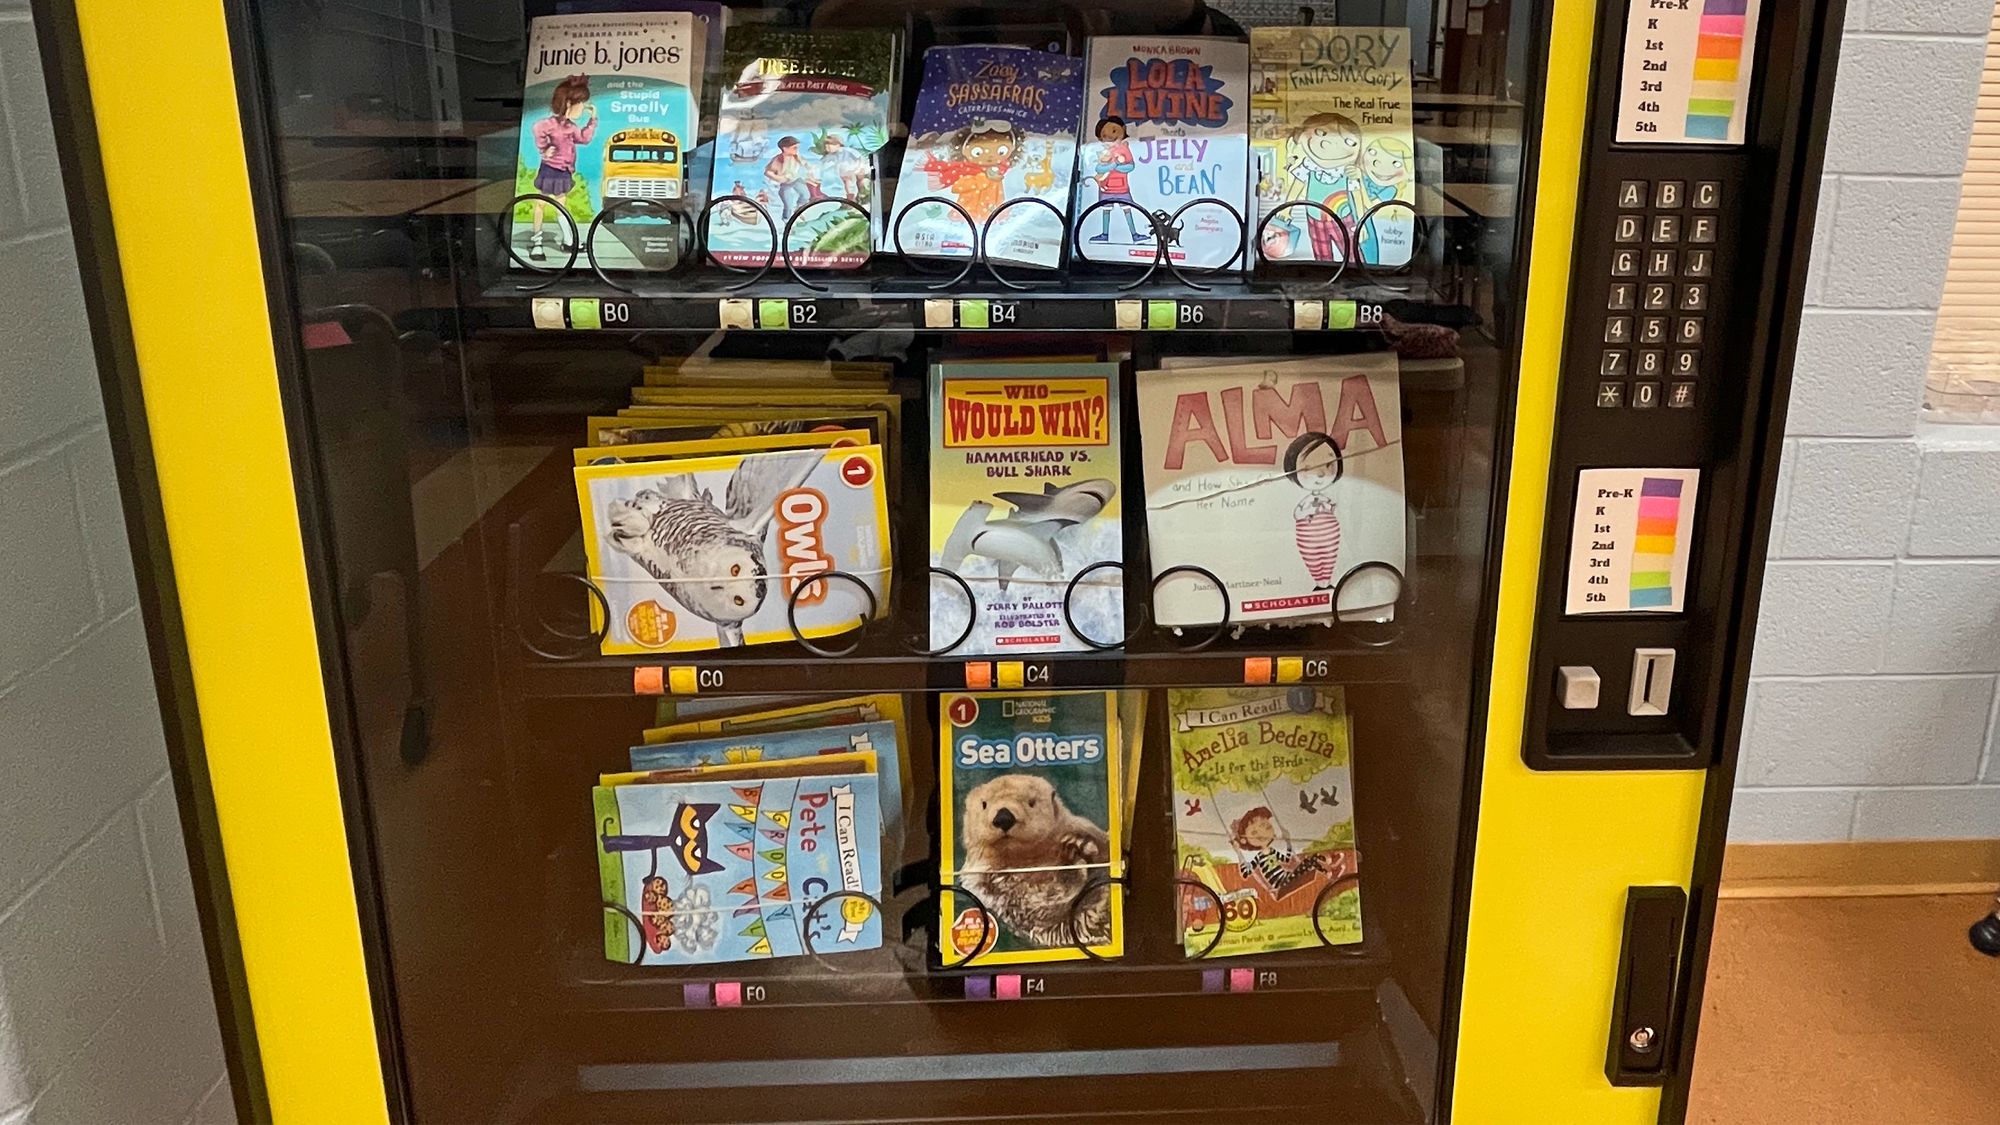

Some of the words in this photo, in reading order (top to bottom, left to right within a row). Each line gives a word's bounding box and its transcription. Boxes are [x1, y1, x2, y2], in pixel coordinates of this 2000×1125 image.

[1648, 19, 1658, 29] K
[1133, 45, 1166, 54] MONICA
[1168, 46, 1201, 55] BROWN
[1300, 34, 1401, 67] DORY
[1645, 39, 1664, 51] 1st
[533, 44, 586, 75] junie
[594, 41, 611, 64] b.
[613, 41, 681, 71] jones
[1643, 60, 1667, 71] 2nd
[974, 59, 1020, 83] Zoey
[1128, 60, 1206, 89] LOLA
[607, 81, 625, 89] and
[1640, 81, 1663, 92] 3rd
[620, 90, 660, 100] Stupid
[946, 84, 1046, 115] SASSAFRAS
[1333, 97, 1351, 109] The
[1354, 97, 1375, 109] Real
[1378, 97, 1400, 109] True
[611, 101, 669, 116] Smelly
[1107, 89, 1225, 120] LEVINE
[1638, 101, 1660, 112] 4th
[629, 114, 650, 123] Bus
[1362, 112, 1393, 126] Friend
[1635, 121, 1657, 132] 5th
[1138, 136, 1209, 164] JELLY
[1174, 160, 1194, 171] and
[1158, 164, 1222, 196] BEAN
[1624, 185, 1638, 203] A
[1662, 185, 1676, 203] B
[1700, 185, 1713, 204] C
[1622, 219, 1635, 238] D
[1659, 219, 1672, 238] E
[1696, 219, 1708, 238] F
[1618, 254, 1631, 272] G
[1655, 254, 1668, 272] H
[1692, 254, 1703, 272] J
[1616, 287, 1624, 305] 1
[1652, 287, 1664, 305] 2
[1688, 287, 1700, 305] 3
[793, 305, 817, 323] B2
[992, 304, 1016, 323] B4
[1180, 305, 1204, 323] B6
[1360, 305, 1383, 323] B8
[1611, 320, 1622, 337] 4
[1648, 320, 1659, 337] 5
[1684, 320, 1696, 337] 6
[1608, 353, 1620, 371] 7
[1644, 353, 1655, 371] 8
[1680, 353, 1692, 371] 9
[1004, 384, 1048, 399] WHO
[1641, 385, 1651, 403] 0
[1675, 385, 1688, 403] #
[948, 397, 1035, 443] WOULD
[1038, 395, 1104, 440] WIN?
[1164, 374, 1388, 470] ALMA
[966, 451, 1064, 464] HAMMERHEAD
[1070, 450, 1091, 462] VS.
[847, 465, 865, 476] 1
[987, 466, 1018, 477] BULL
[1024, 465, 1071, 477] SHARK
[1172, 482, 1192, 492] and
[1198, 479, 1221, 492] How
[1598, 489, 1633, 498] Pre-K
[1221, 497, 1255, 509] Name
[1596, 506, 1605, 515] K
[1594, 524, 1610, 533] 1st
[781, 493, 829, 600] Owls
[1591, 541, 1615, 550] 2nd
[1589, 558, 1610, 567] 3rd
[1588, 575, 1608, 584] 4th
[1254, 595, 1329, 610] SCHOLASTIC
[1586, 593, 1606, 602] 5th
[986, 603, 1018, 611] JERRY
[995, 621, 1015, 629] ROB
[1019, 619, 1060, 628] BOLSTER
[1026, 665, 1049, 683] C4
[1306, 660, 1328, 677] C6
[957, 704, 966, 721] 1
[1015, 707, 1056, 716] GEOGRAPHIC
[1200, 711, 1205, 723] I
[1209, 709, 1238, 724] Can
[1242, 699, 1282, 717] Read!
[960, 739, 1010, 765] Sea
[1016, 737, 1100, 763] Otters
[1183, 727, 1249, 773] Amelia
[1258, 721, 1335, 759] Bedelia
[1229, 762, 1245, 772] for
[1273, 755, 1303, 768] Birds
[736, 790, 757, 857] BAKE
[799, 793, 829, 852] Pete
[838, 816, 851, 844] Can
[843, 849, 860, 890] Read!
[1026, 979, 1045, 993] F4
[1260, 972, 1277, 986] F8
